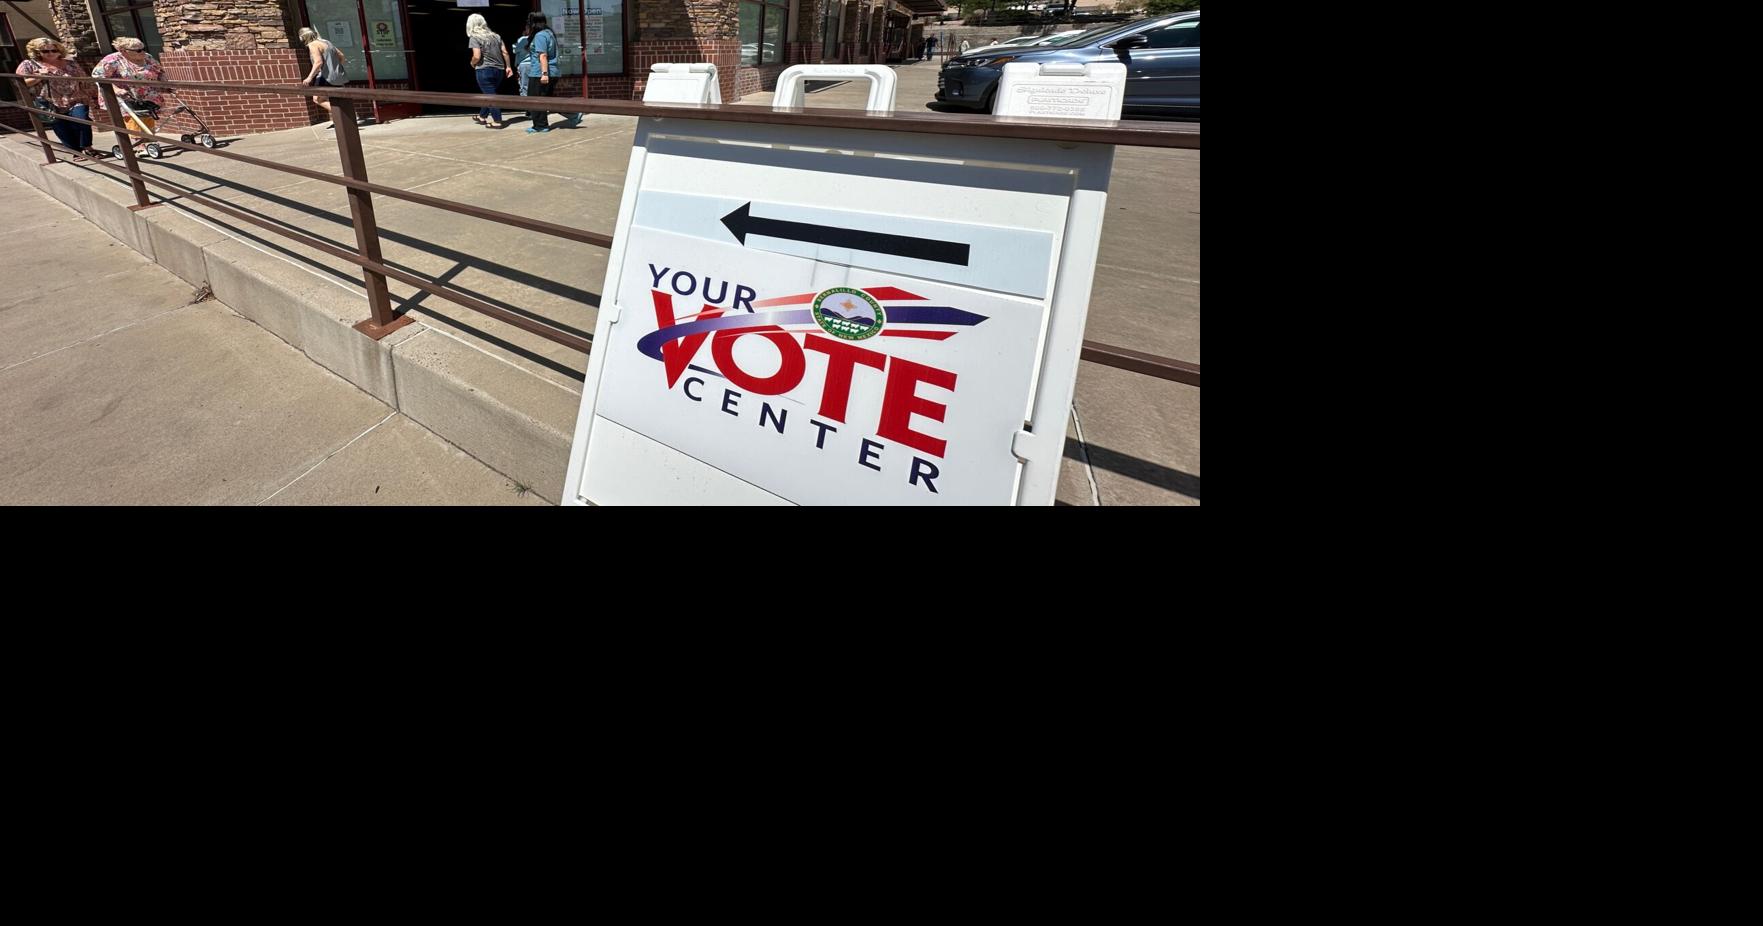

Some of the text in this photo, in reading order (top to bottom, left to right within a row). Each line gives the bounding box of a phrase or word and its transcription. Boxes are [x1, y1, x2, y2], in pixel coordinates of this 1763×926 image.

[648, 263, 757, 314] YOUR
[817, 287, 883, 317] BERNALILLO COUNTY
[651, 289, 958, 459] VOTE
[682, 376, 940, 495] CENTER
